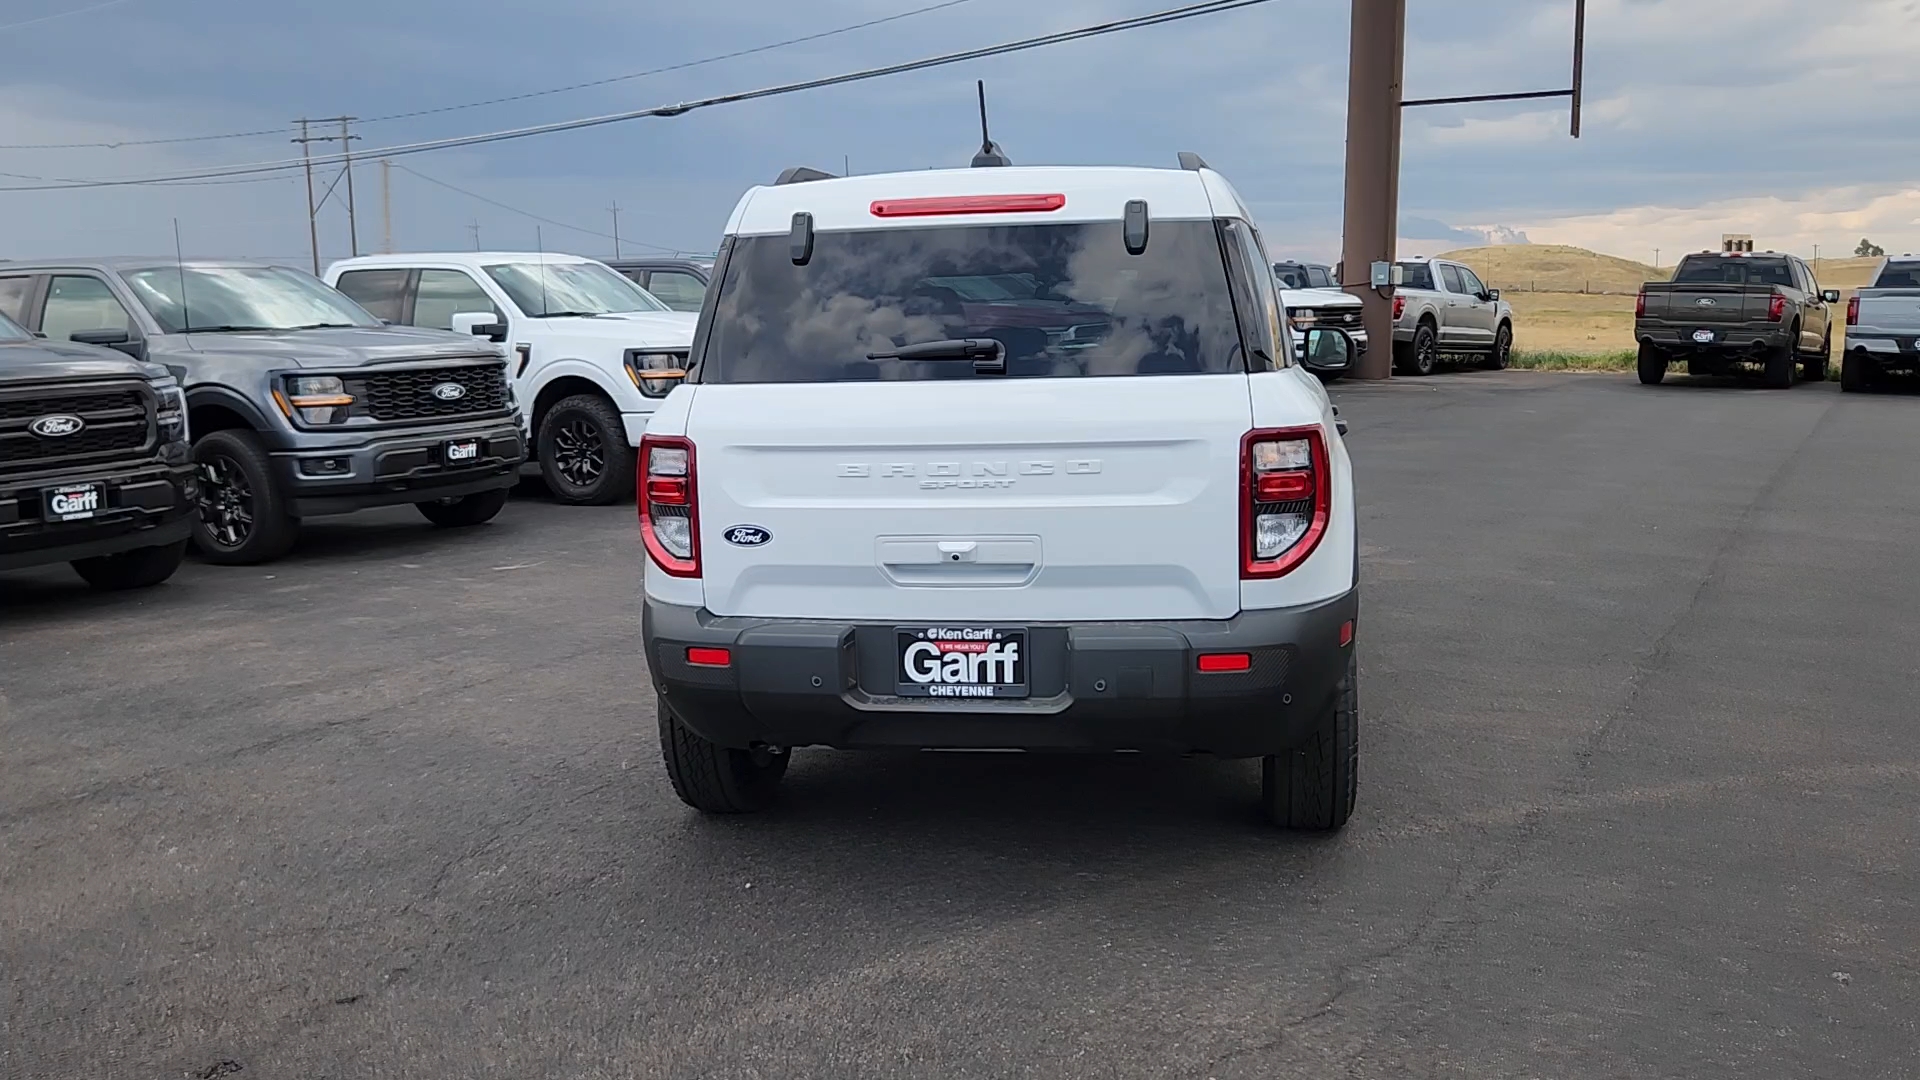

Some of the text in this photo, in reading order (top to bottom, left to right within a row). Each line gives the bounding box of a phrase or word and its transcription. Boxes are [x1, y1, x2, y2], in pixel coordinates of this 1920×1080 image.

[43, 418, 74, 433] Ford
[448, 443, 477, 459] Garff
[836, 459, 1103, 478] BRONCO
[919, 479, 1016, 489] SPORT
[51, 491, 98, 514] Garff
[731, 528, 763, 543] Ford
[938, 628, 994, 640] Ken Garff
[904, 641, 1018, 683] Garff
[929, 685, 994, 697] CHEYENNE
